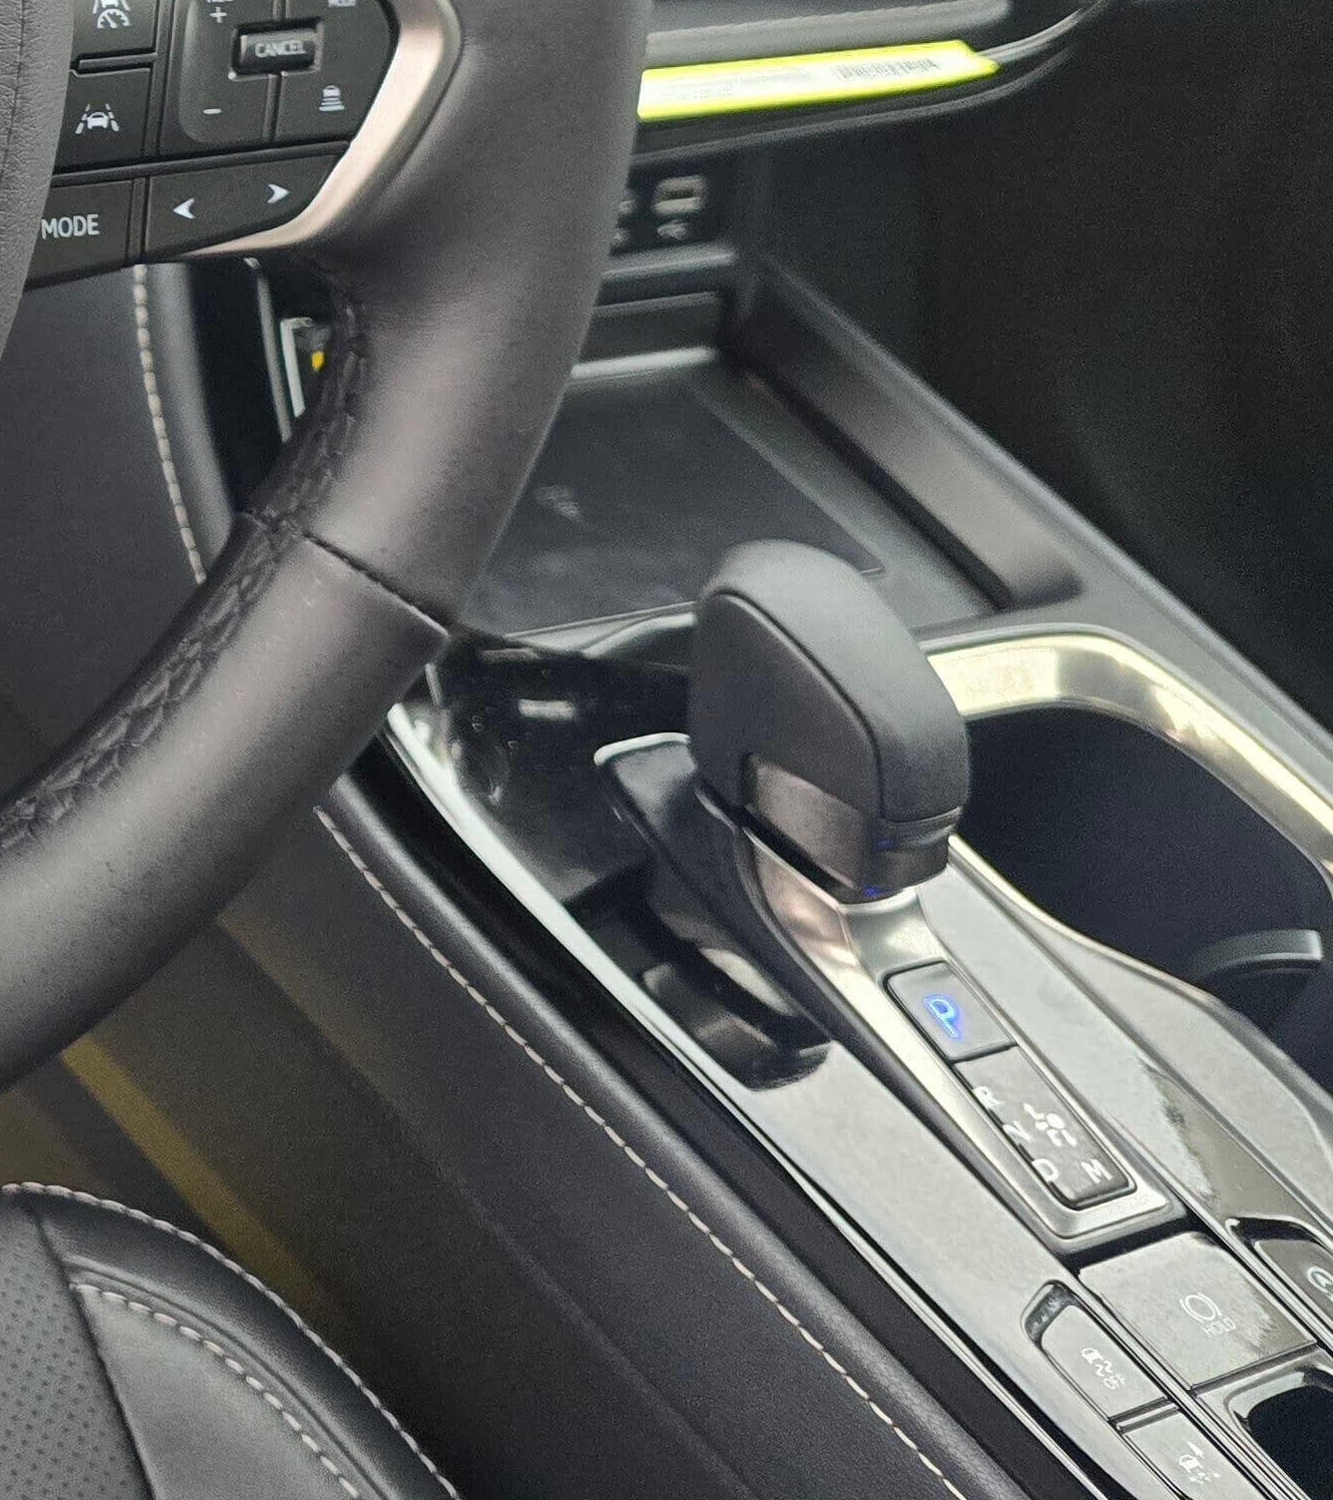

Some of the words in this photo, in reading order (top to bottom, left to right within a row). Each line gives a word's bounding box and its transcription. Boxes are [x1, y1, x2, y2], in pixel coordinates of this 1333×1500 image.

[254, 40, 307, 58] CANCEL
[42, 214, 100, 240] MODE
[926, 994, 959, 1040] P
[973, 1085, 1004, 1109] R
[1031, 1157, 1060, 1183] D
[1080, 1158, 1114, 1185] M
[1203, 1317, 1237, 1338] HOLD
